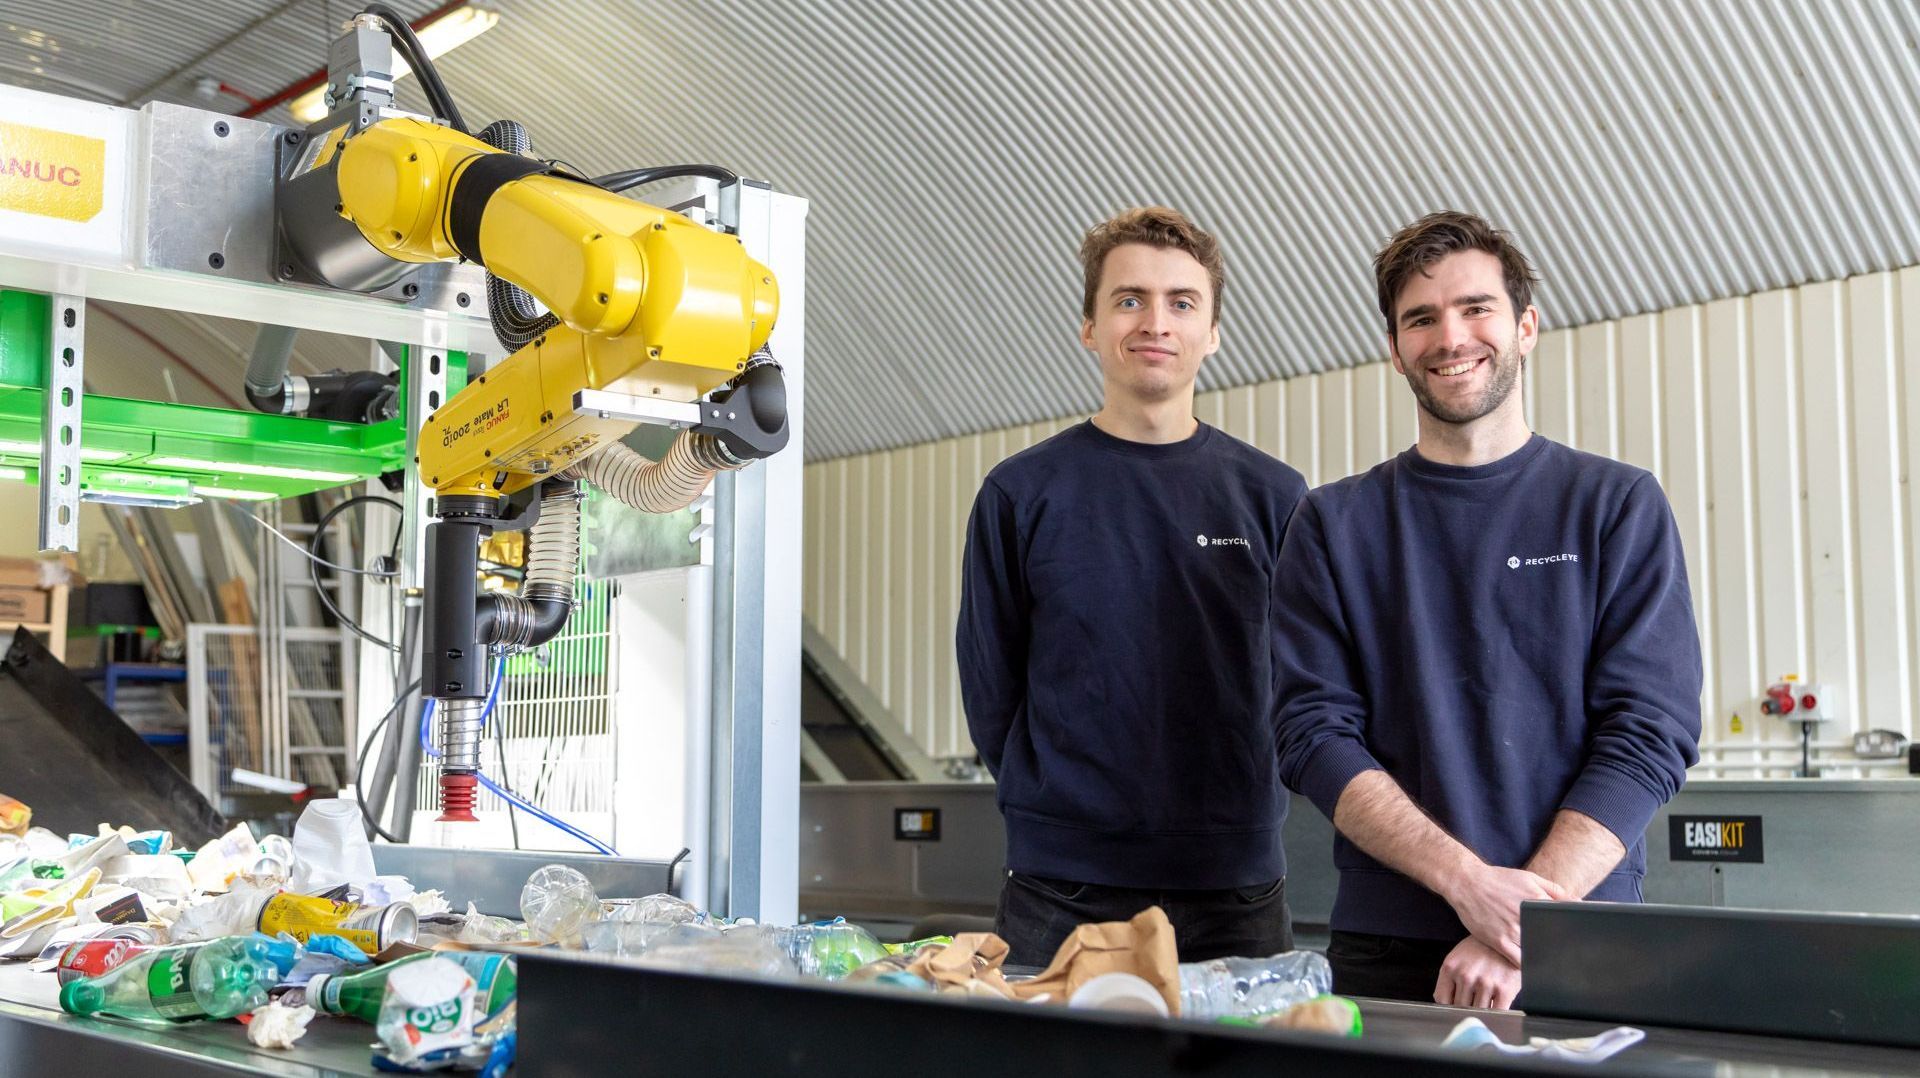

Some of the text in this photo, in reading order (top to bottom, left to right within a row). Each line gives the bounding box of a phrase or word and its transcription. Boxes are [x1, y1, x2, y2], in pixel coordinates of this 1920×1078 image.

[497, 398, 509, 413] LR
[473, 407, 494, 426] Mate
[485, 408, 510, 431] FANUC
[1525, 553, 1579, 566] RECYCLEYE
[1684, 821, 1745, 849] EASIKIT
